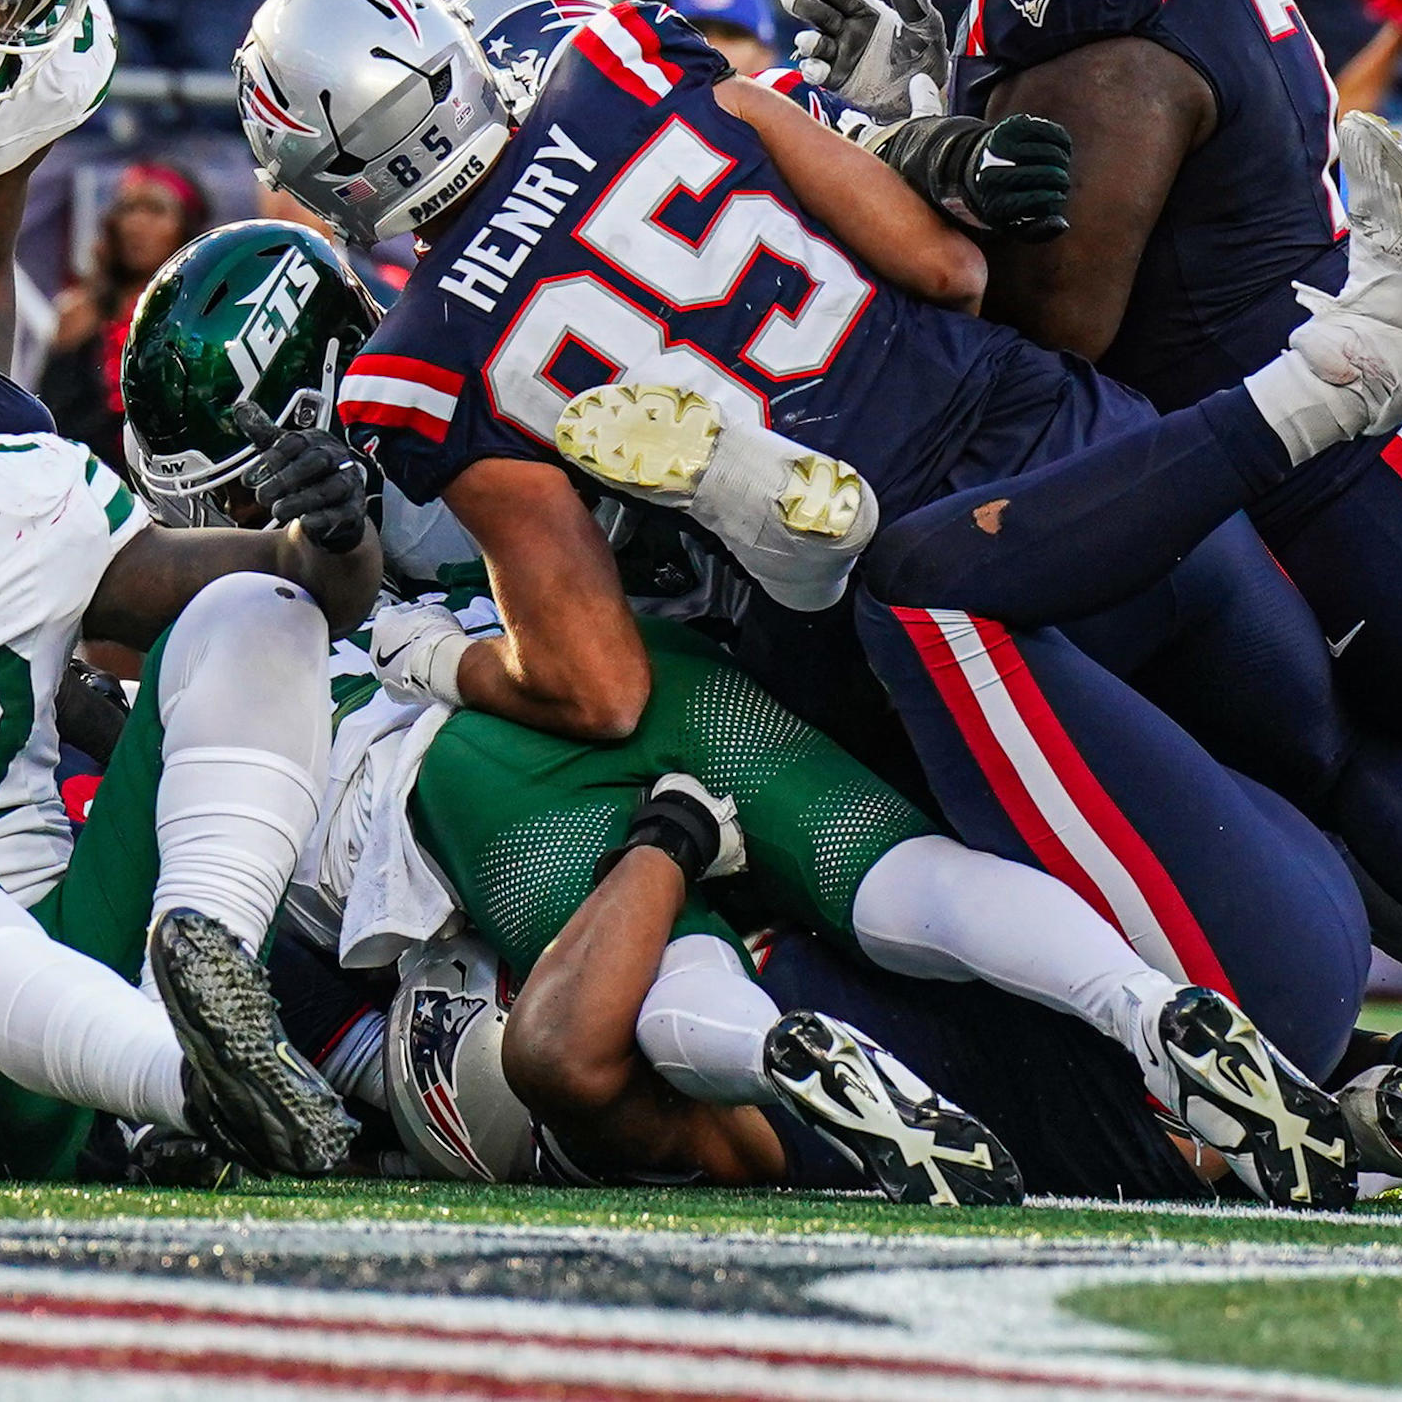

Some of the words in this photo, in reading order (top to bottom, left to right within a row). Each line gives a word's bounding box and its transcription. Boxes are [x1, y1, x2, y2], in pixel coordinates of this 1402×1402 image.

[387, 124, 453, 188] 85
[408, 154, 486, 225] PATRIOTS
[438, 122, 597, 312] HENRY
[481, 112, 877, 450] 85
[160, 460, 187, 475] NY
